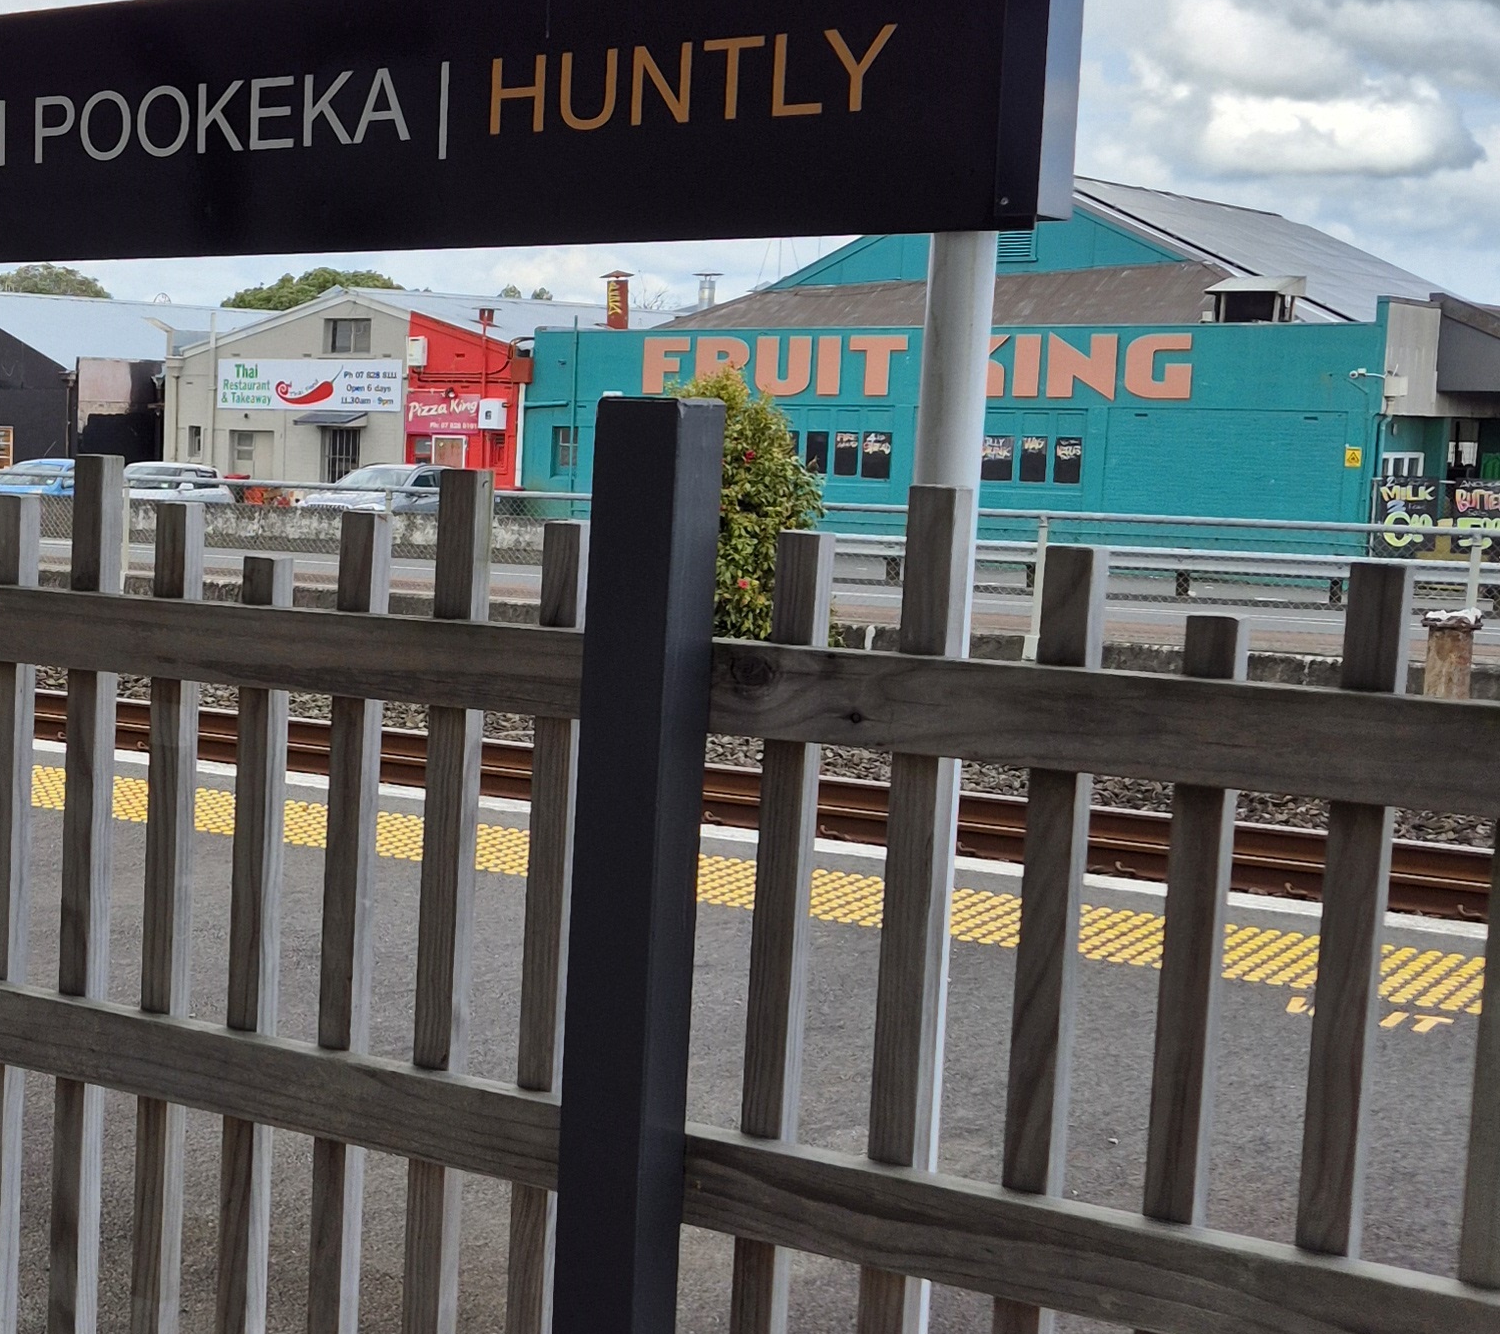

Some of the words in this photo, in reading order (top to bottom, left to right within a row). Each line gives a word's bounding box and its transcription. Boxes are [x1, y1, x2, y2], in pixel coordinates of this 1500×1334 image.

[34, 67, 411, 164] POOKEKA
[489, 22, 898, 136] HUNTLY
[234, 363, 258, 378] Thai
[641, 333, 909, 397] FRUIT
[223, 379, 270, 390] Restaurant
[346, 384, 365, 393] Open
[367, 384, 372, 392] 6
[374, 384, 391, 393] days
[221, 391, 228, 403] &
[231, 391, 272, 406] Takeaway
[409, 401, 447, 421] Pizza
[450, 399, 478, 415] King
